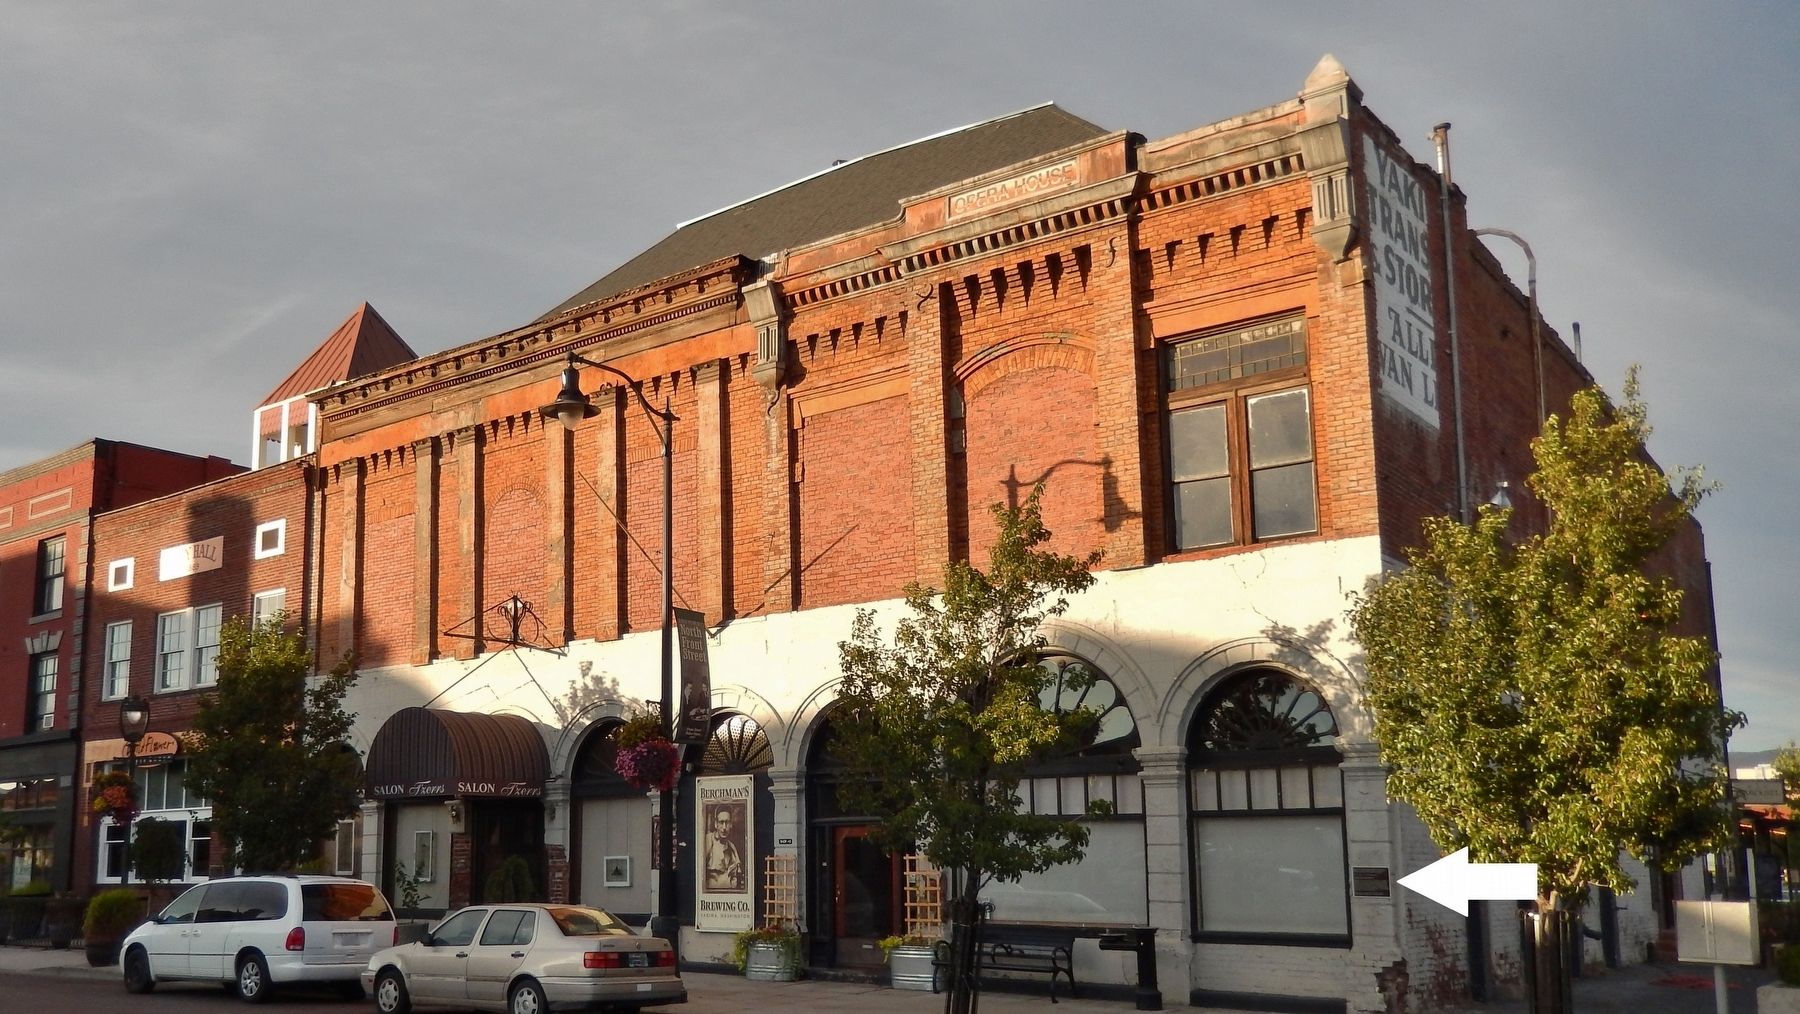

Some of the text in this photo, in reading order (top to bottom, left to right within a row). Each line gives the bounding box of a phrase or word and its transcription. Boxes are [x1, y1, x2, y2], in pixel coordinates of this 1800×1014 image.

[955, 163, 1074, 213] OPERA HOUSE
[193, 544, 217, 562] HALL
[679, 623, 703, 638] North
[681, 636, 704, 650] Front
[682, 648, 706, 662] Street
[374, 784, 405, 796] SALON
[457, 782, 496, 794] SALON
[700, 785, 750, 799] BERCHMAN'S
[700, 899, 736, 911] BREWING
